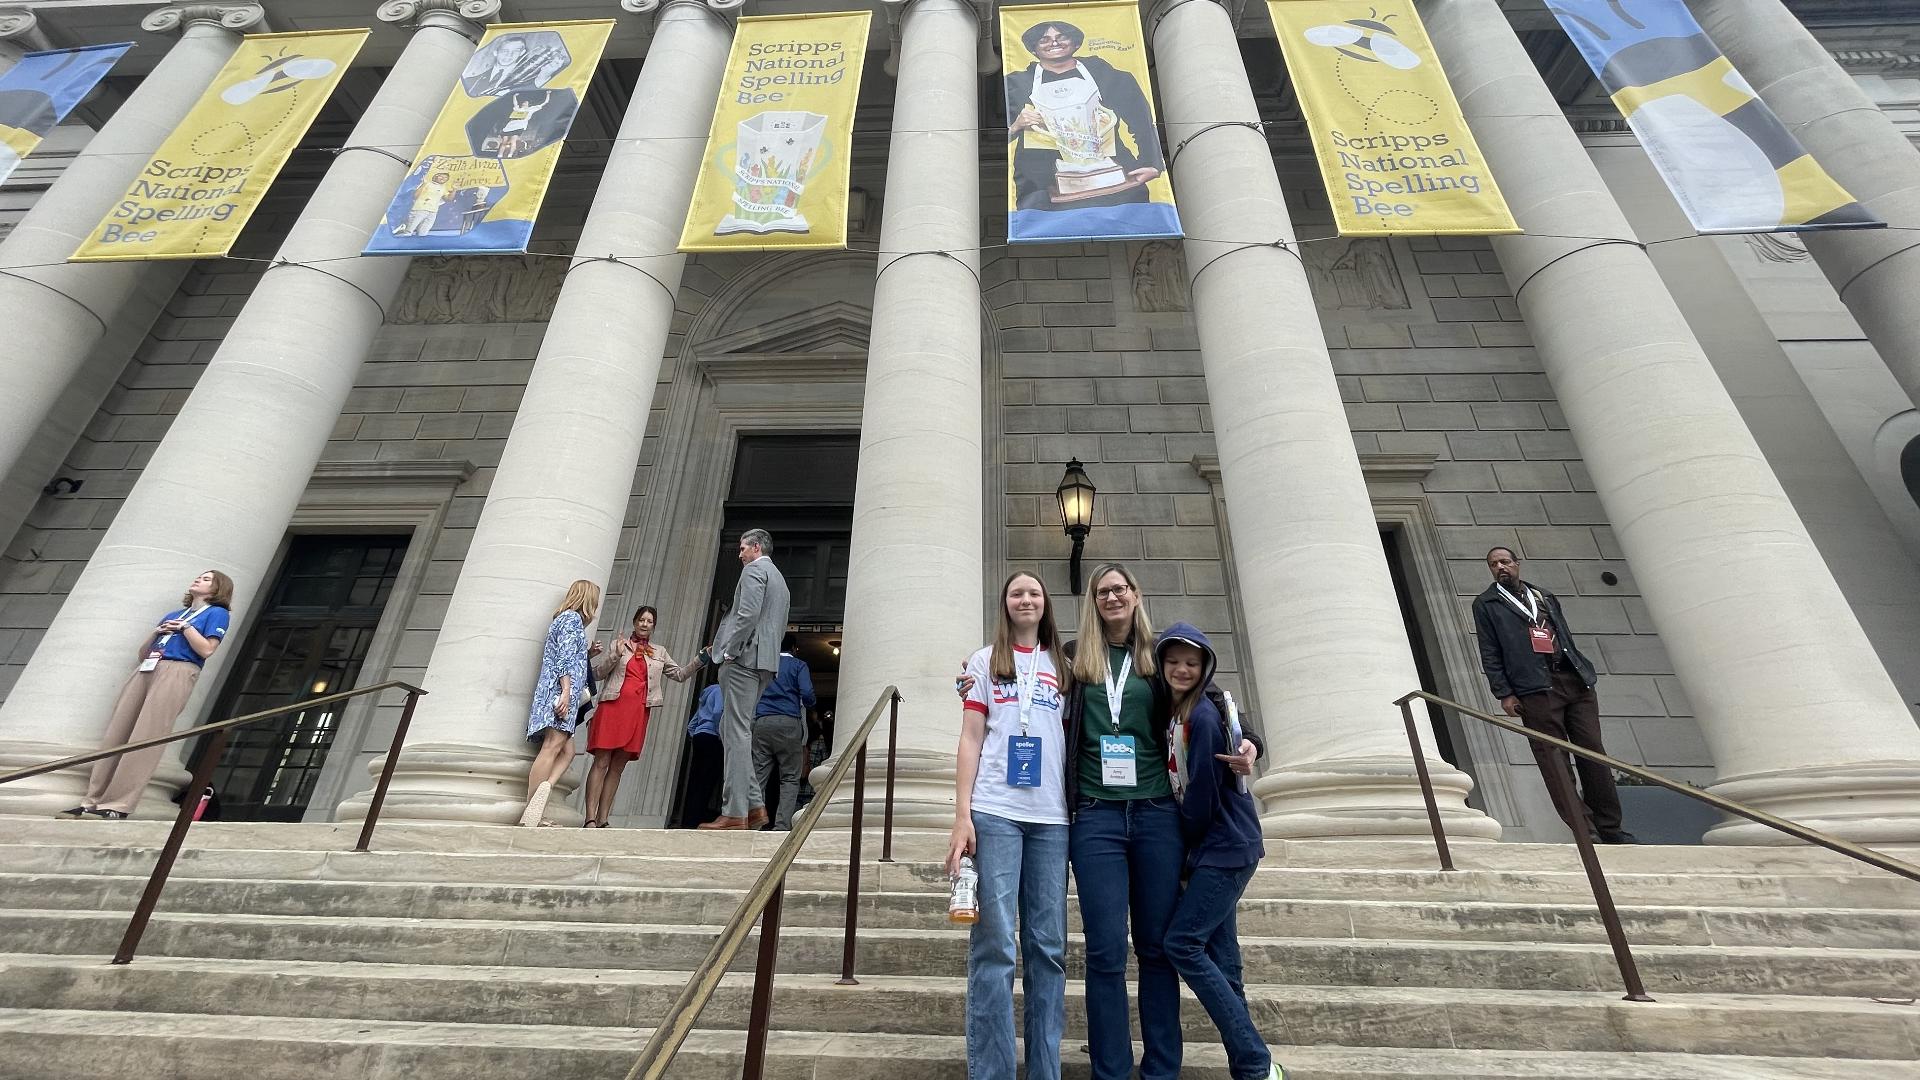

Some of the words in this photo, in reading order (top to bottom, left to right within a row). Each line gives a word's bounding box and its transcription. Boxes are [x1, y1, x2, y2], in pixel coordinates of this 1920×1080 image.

[748, 40, 842, 56] Scripps
[744, 51, 845, 73] National
[740, 67, 846, 91] Spelling
[736, 90, 783, 104] Bee
[1331, 130, 1449, 151] Scripps
[145, 159, 253, 183] Scripps
[1337, 148, 1469, 172] National
[128, 178, 248, 200] National
[1345, 172, 1480, 197] Spelling
[114, 201, 238, 224] Spelling
[1351, 195, 1413, 216] Bee
[98, 224, 157, 243] Bee
[1103, 740, 1126, 752] bee
